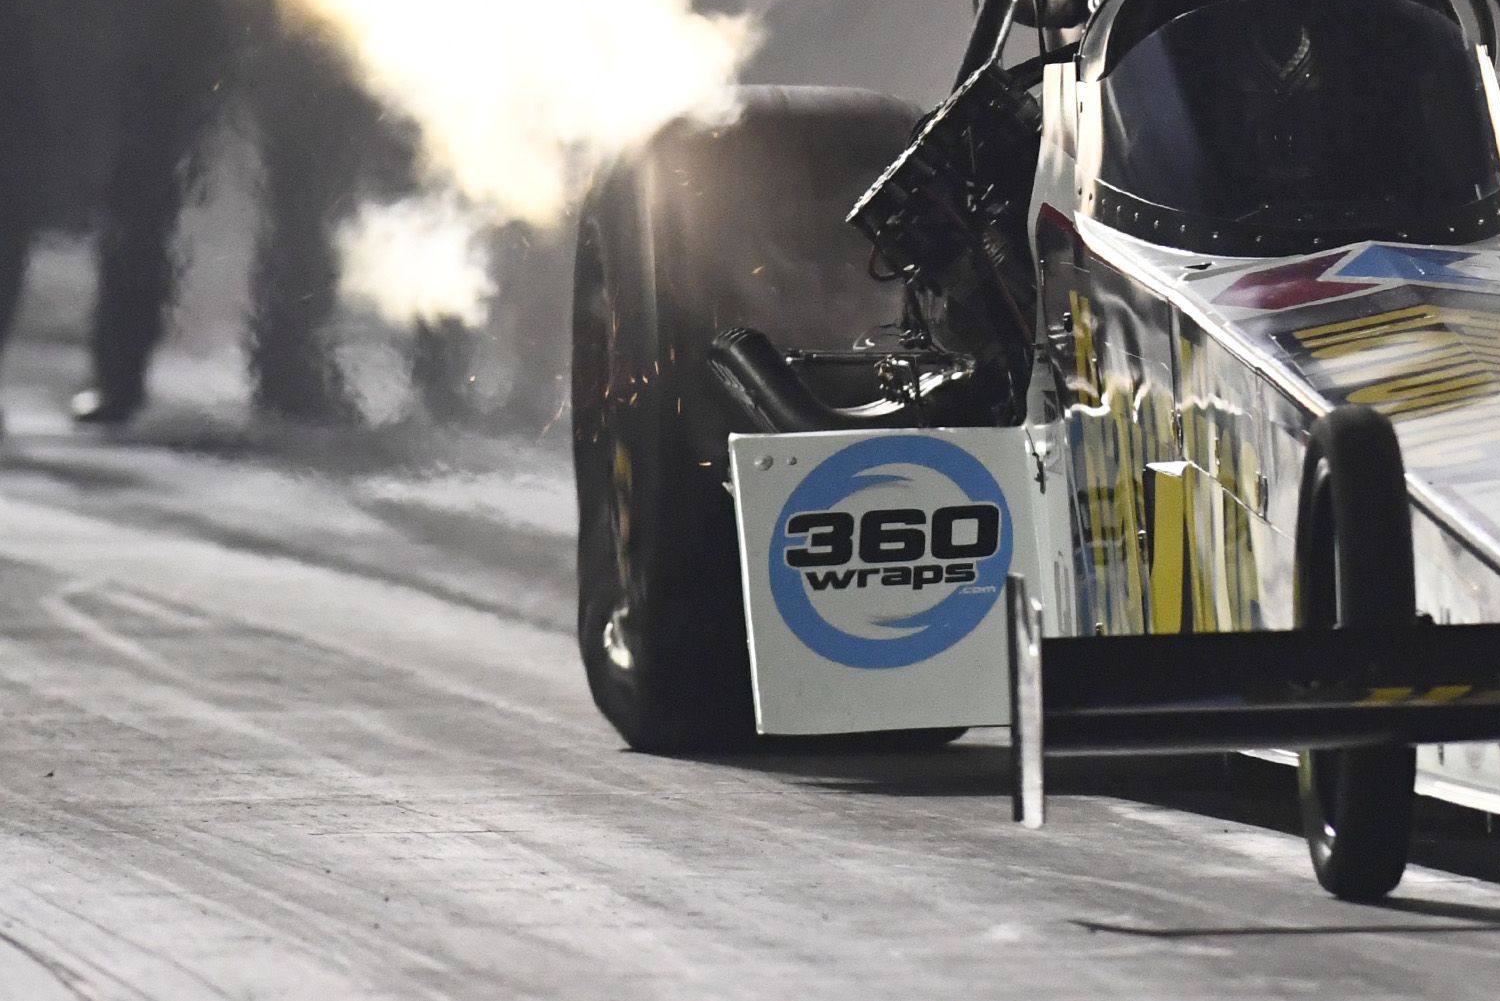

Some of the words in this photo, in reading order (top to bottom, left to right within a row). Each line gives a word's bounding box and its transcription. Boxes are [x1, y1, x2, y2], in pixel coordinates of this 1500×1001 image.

[785, 504, 1000, 567] 360
[805, 562, 976, 591] wraps
[958, 584, 996, 595] .com
